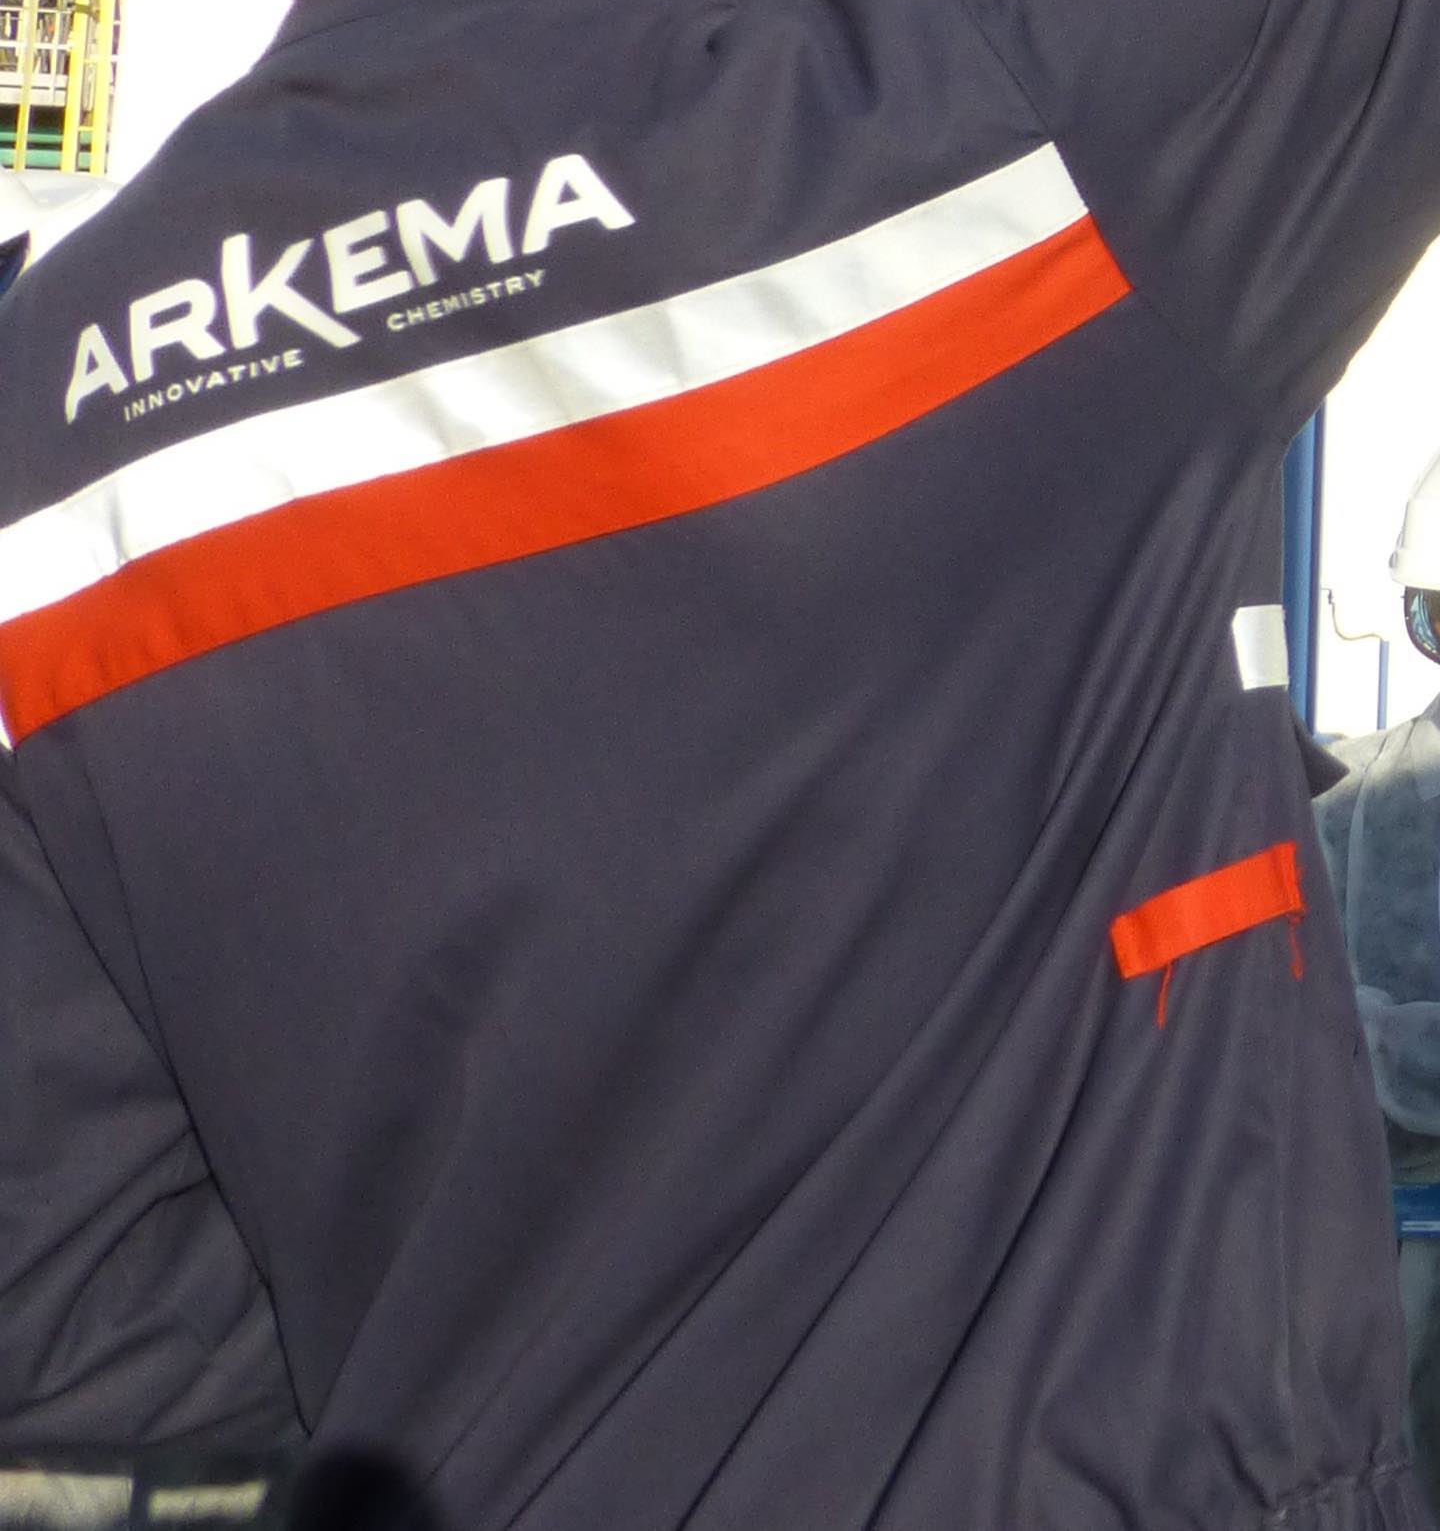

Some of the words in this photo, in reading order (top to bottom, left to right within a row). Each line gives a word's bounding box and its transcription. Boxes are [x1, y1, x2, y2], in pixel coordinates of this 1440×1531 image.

[64, 153, 637, 425] ARKEMA
[123, 347, 305, 422] INNOVATIVE
[386, 269, 547, 333] CHEMISTRY
